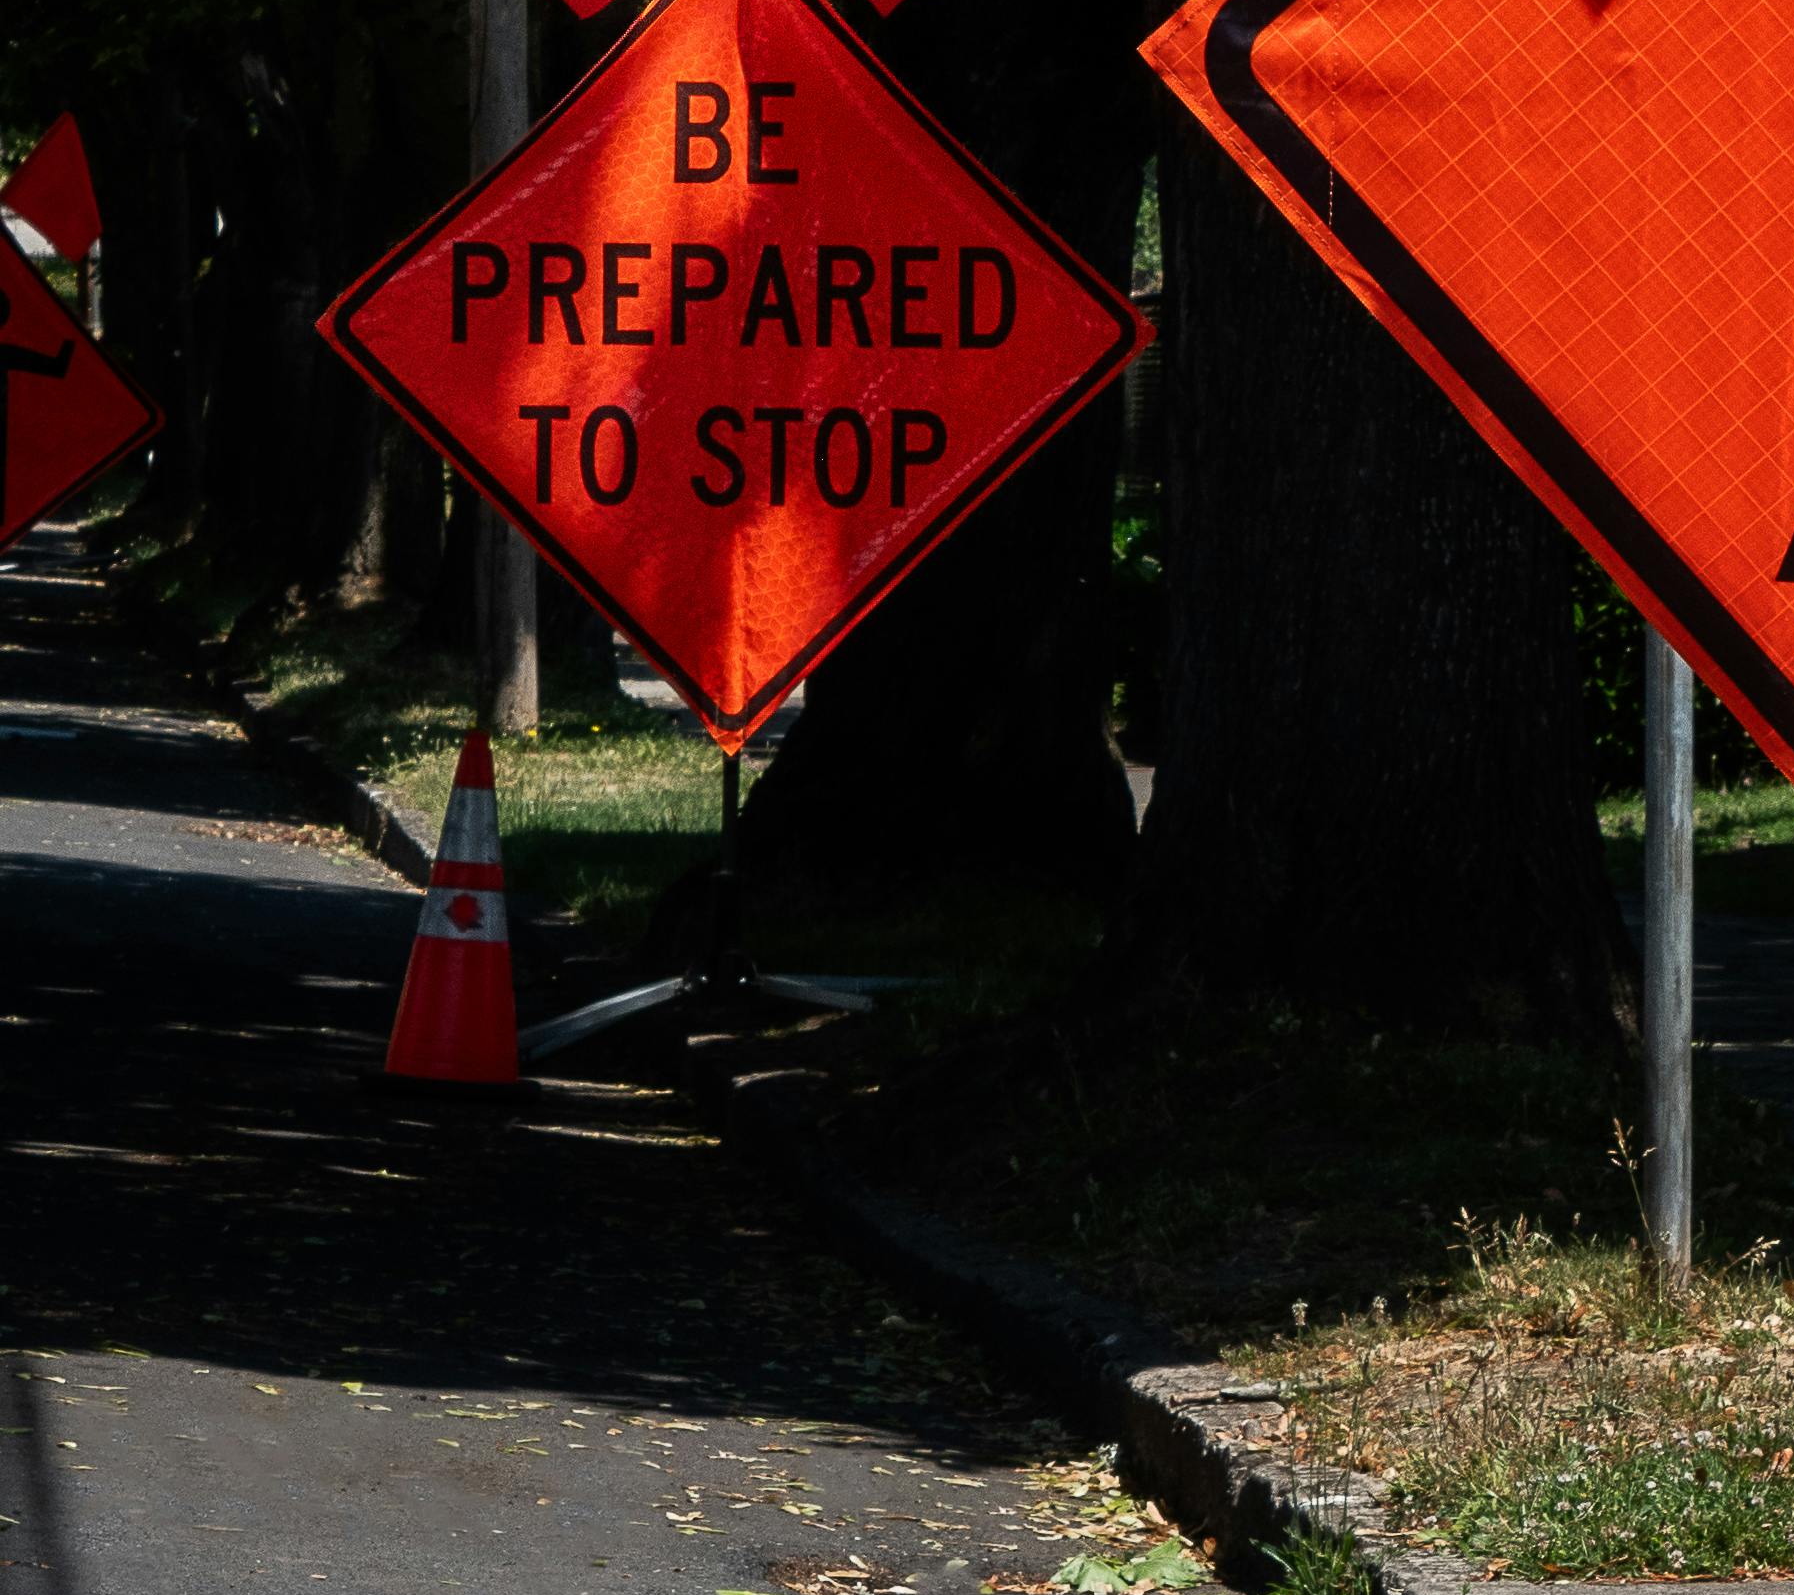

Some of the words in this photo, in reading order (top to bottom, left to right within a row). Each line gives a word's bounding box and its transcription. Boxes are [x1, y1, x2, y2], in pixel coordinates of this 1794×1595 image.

[673, 81, 800, 185] BE
[451, 241, 1018, 350] PREPARED
[518, 405, 639, 507] TO
[690, 405, 949, 510] STOP
